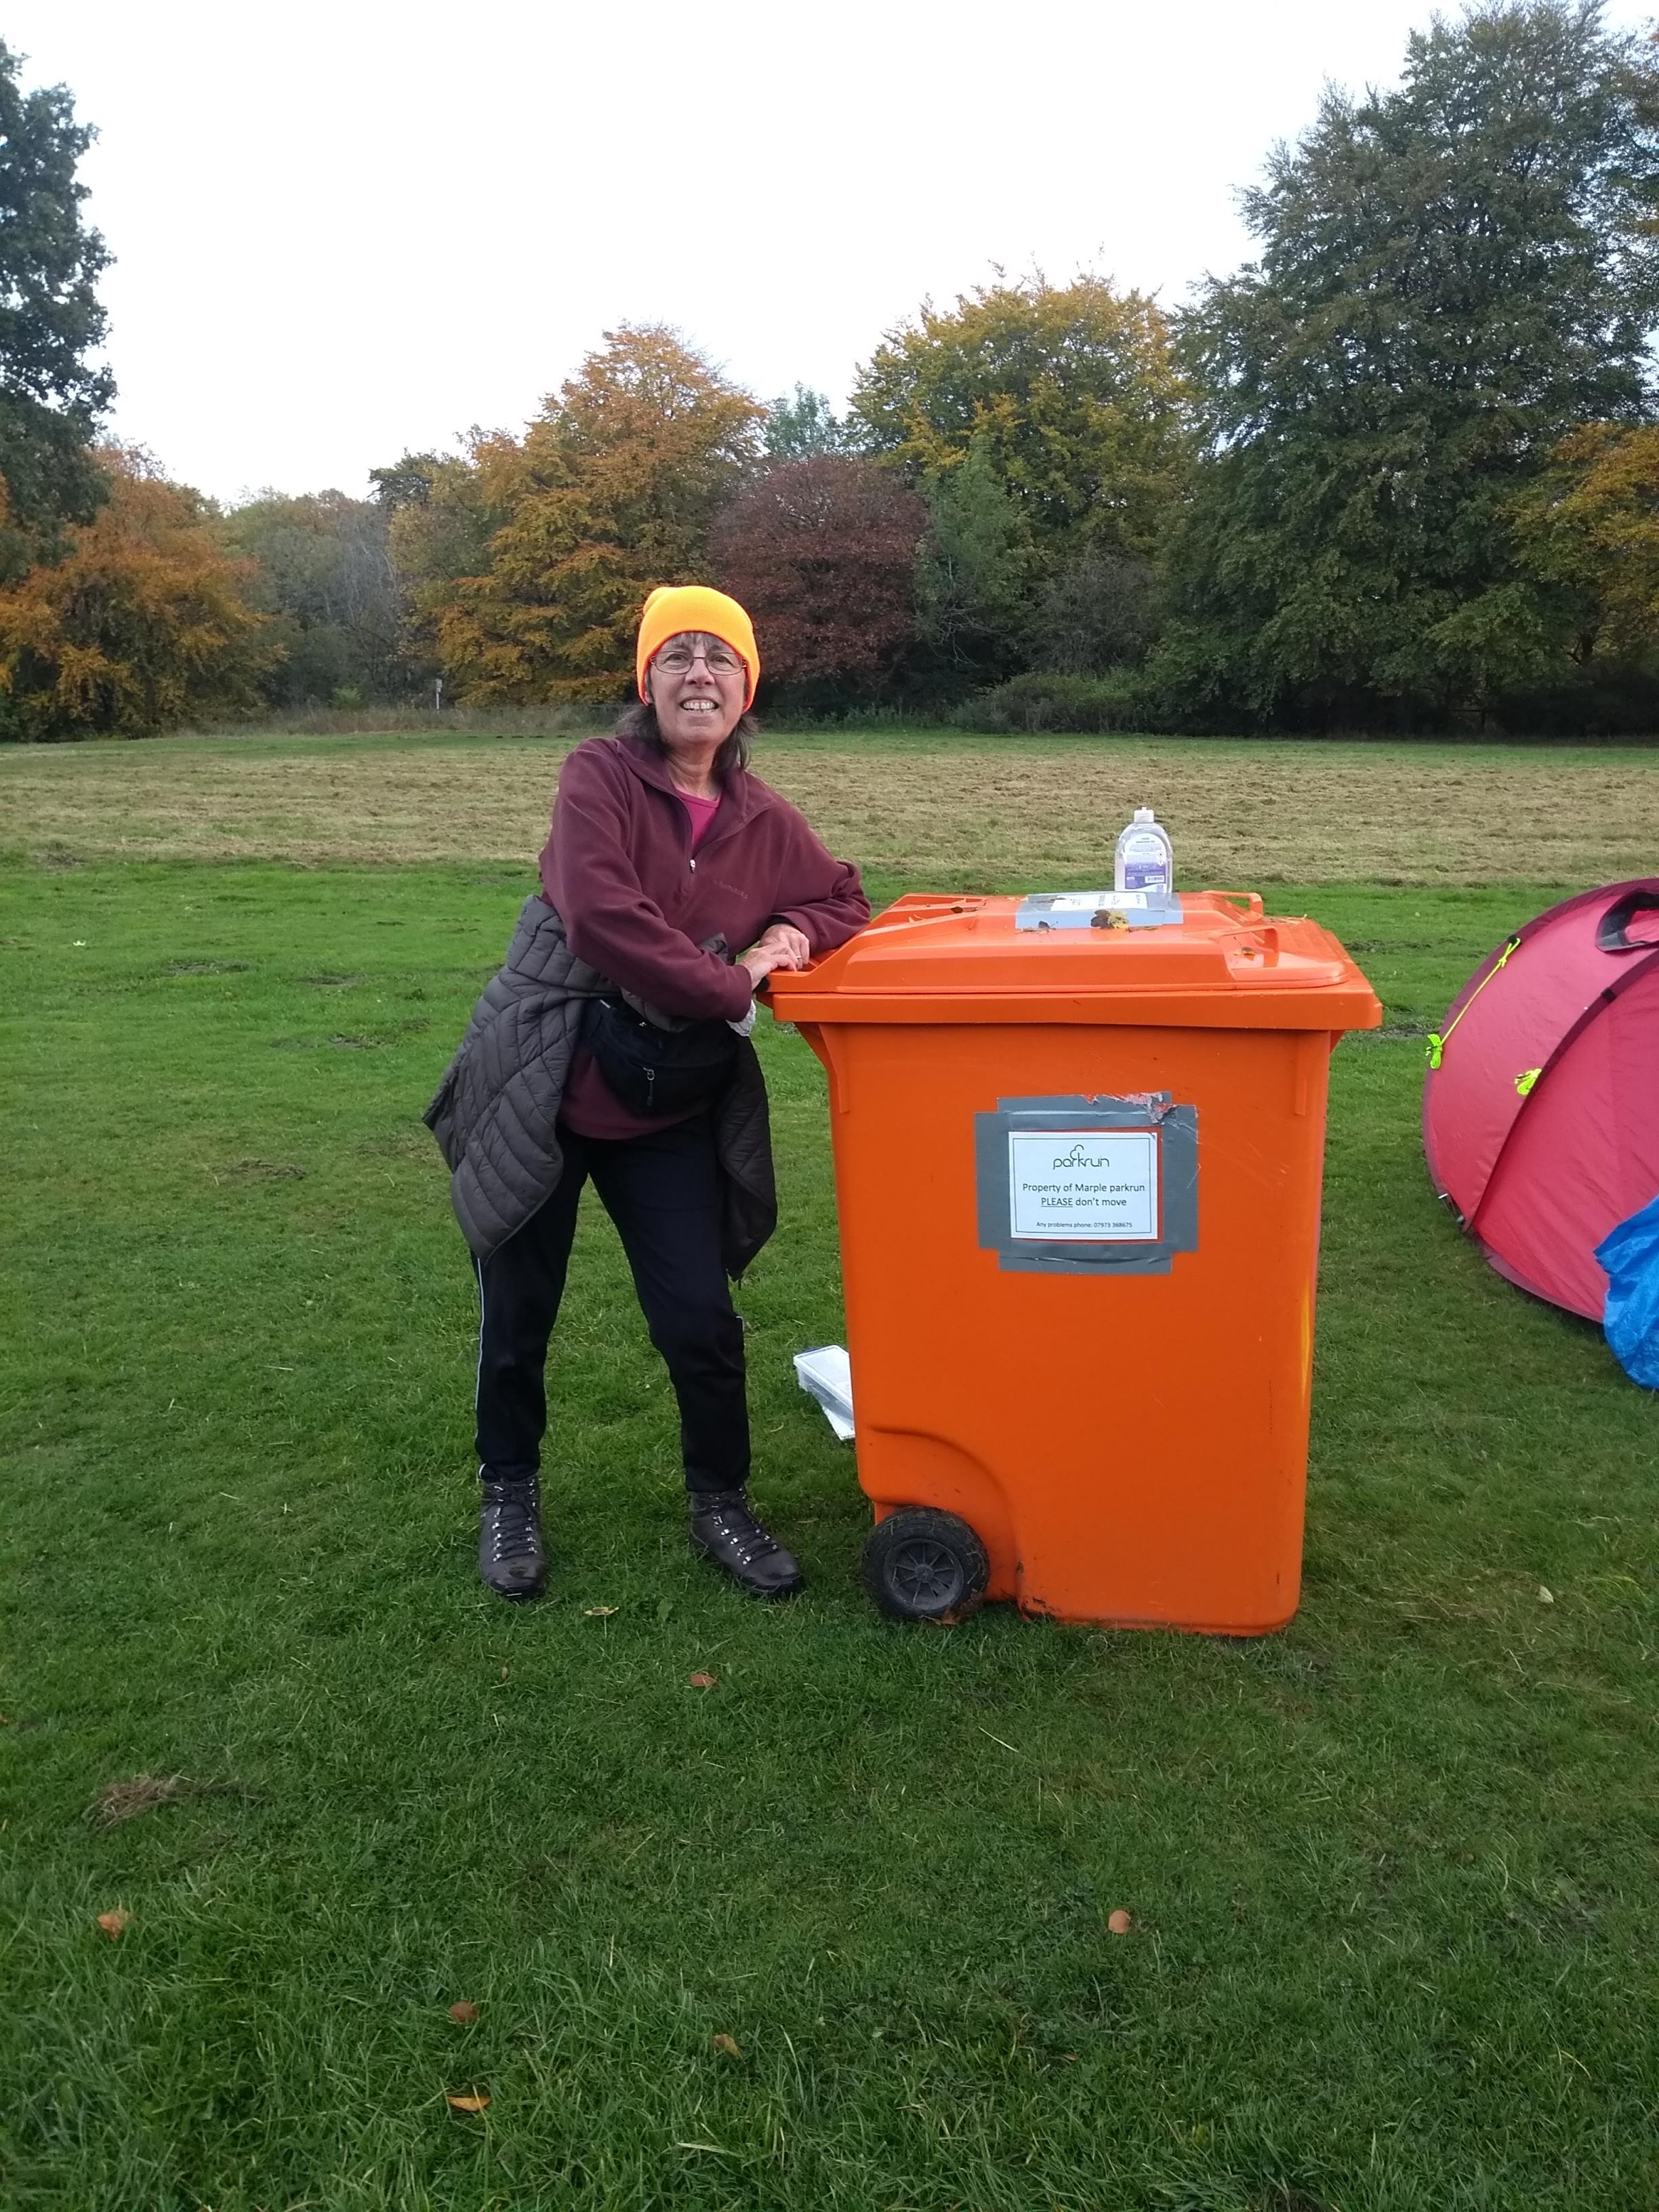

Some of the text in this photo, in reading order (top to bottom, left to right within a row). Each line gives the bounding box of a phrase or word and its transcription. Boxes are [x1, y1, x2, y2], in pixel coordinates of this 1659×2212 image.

[1052, 1145, 1109, 1170] parkrun
[1023, 1183, 1145, 1193] Property of Marple parkrun
[1041, 1197, 1073, 1206] PLEASE
[1076, 1197, 1099, 1206] don't
